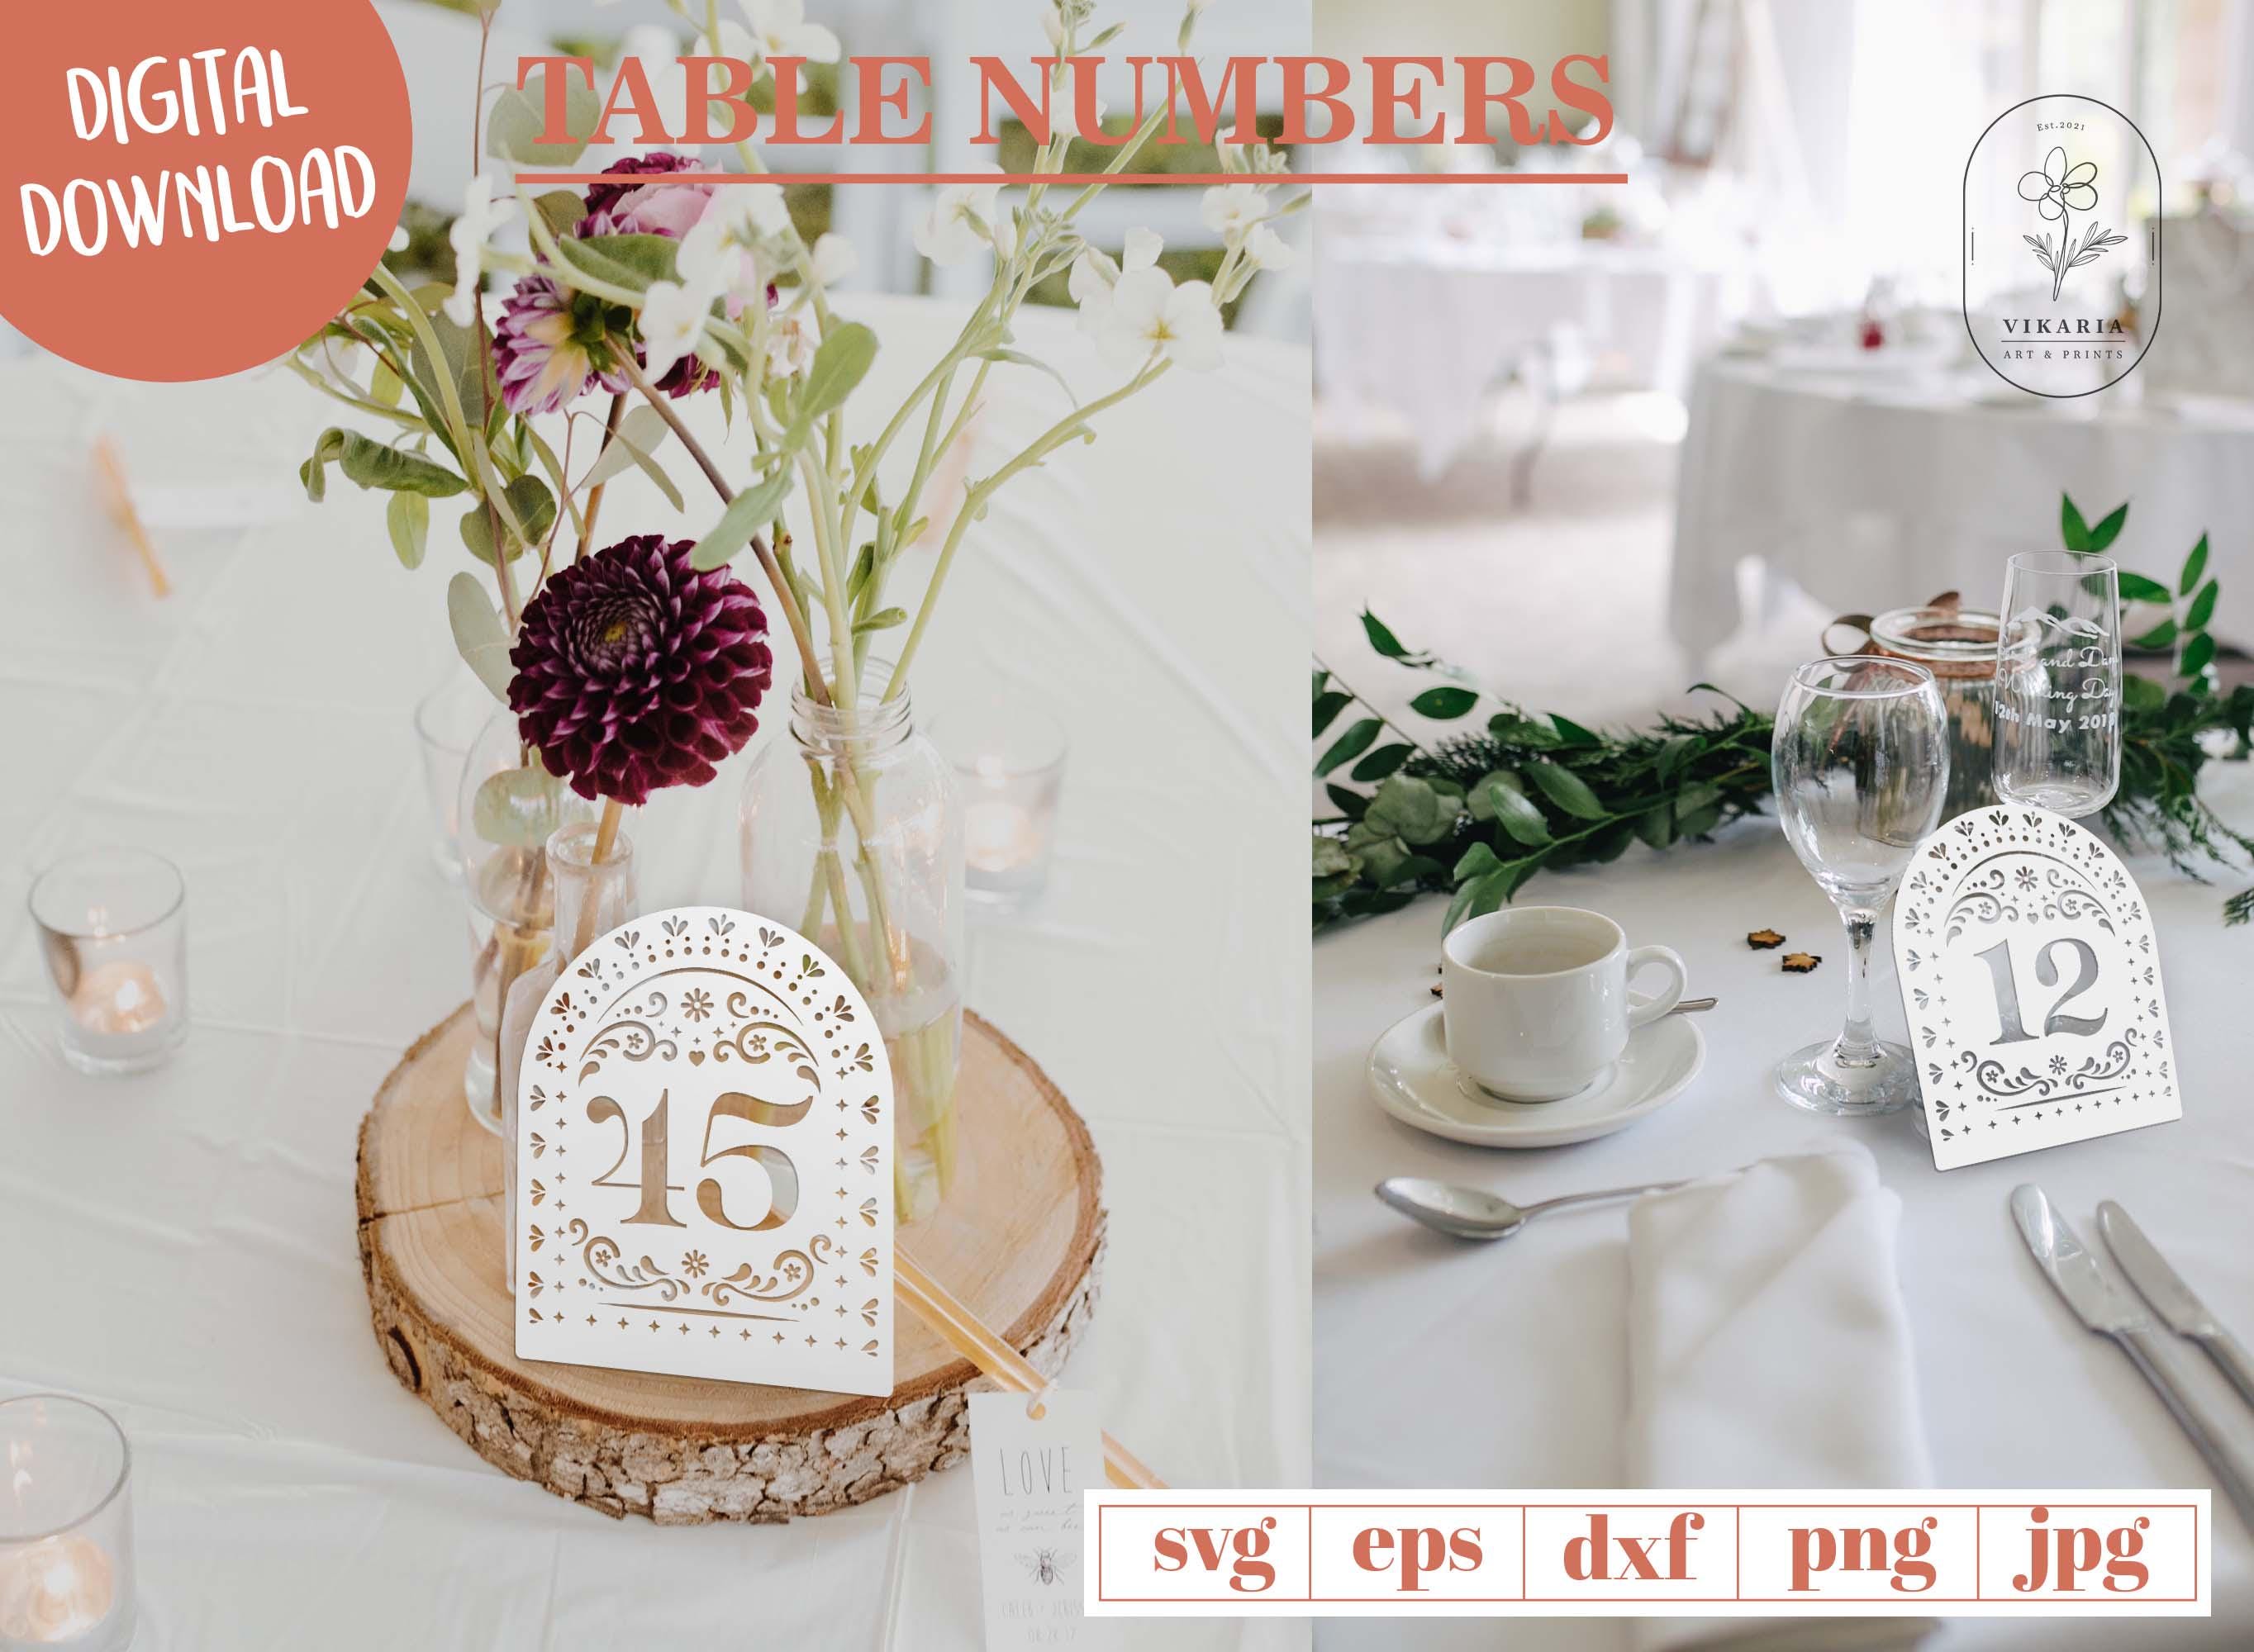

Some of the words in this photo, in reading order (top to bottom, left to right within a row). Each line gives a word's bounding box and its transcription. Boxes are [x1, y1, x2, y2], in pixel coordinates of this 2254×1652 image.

[2026, 712, 2071, 733] May
[1973, 938, 2108, 1046] 12
[586, 1088, 813, 1232] 45
[1000, 1446, 1072, 1496] LOVE
